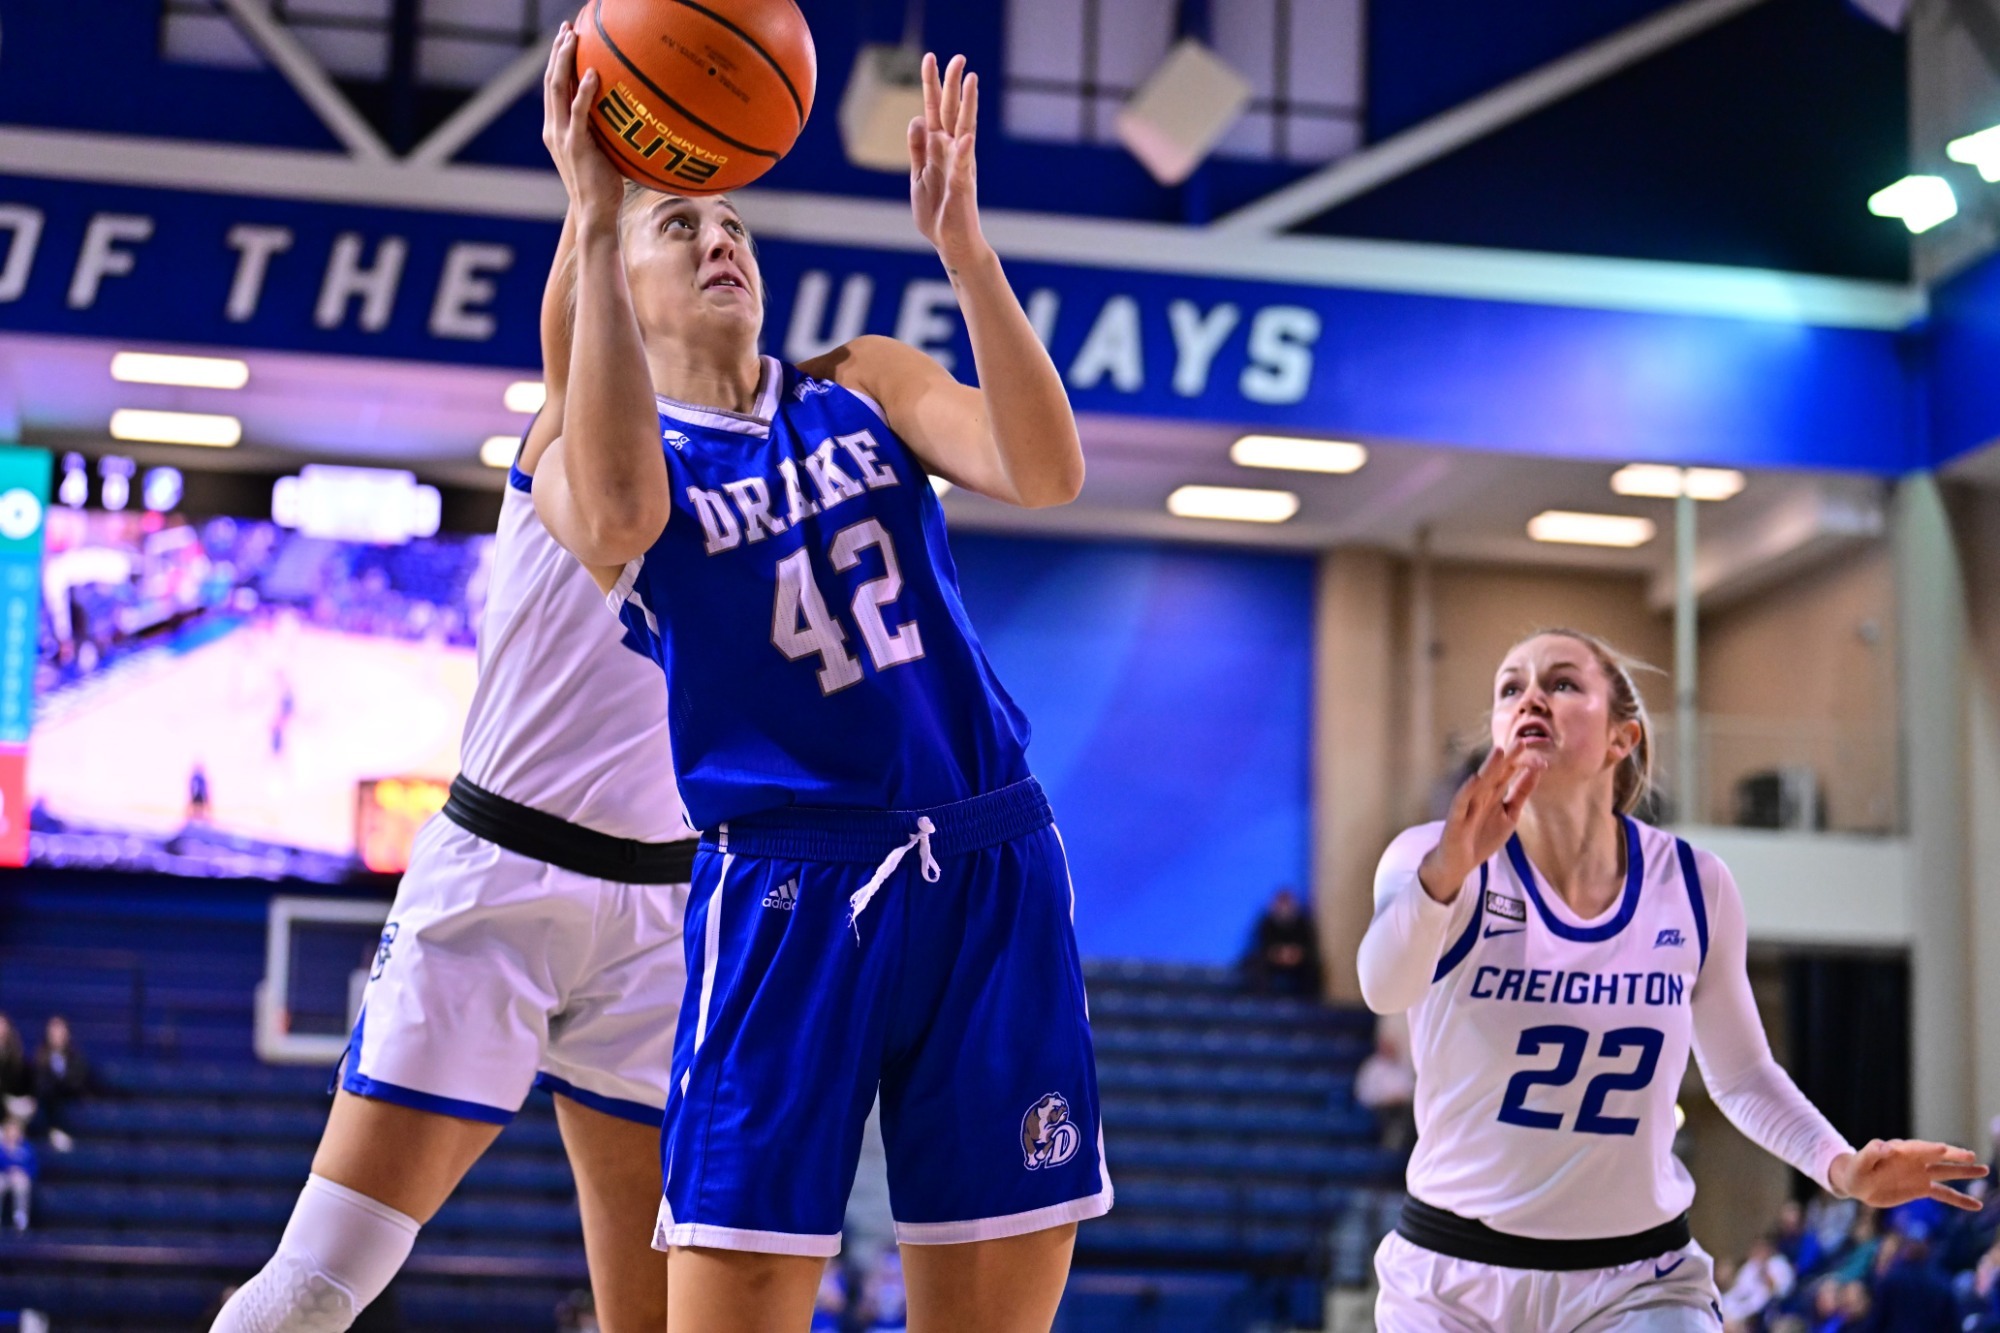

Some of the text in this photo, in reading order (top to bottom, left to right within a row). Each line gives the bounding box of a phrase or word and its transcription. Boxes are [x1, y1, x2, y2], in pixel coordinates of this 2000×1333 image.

[597, 88, 720, 184] ELITE
[616, 80, 729, 164] CHAMPIONSHIP
[225, 225, 514, 340] THE
[783, 268, 1322, 404] UEAYS
[686, 427, 900, 557] DRAKE
[770, 516, 926, 697] 42
[761, 896, 797, 911] adid
[1470, 966, 1684, 1006] CREIGHTON
[1497, 1024, 1665, 1136] 22
